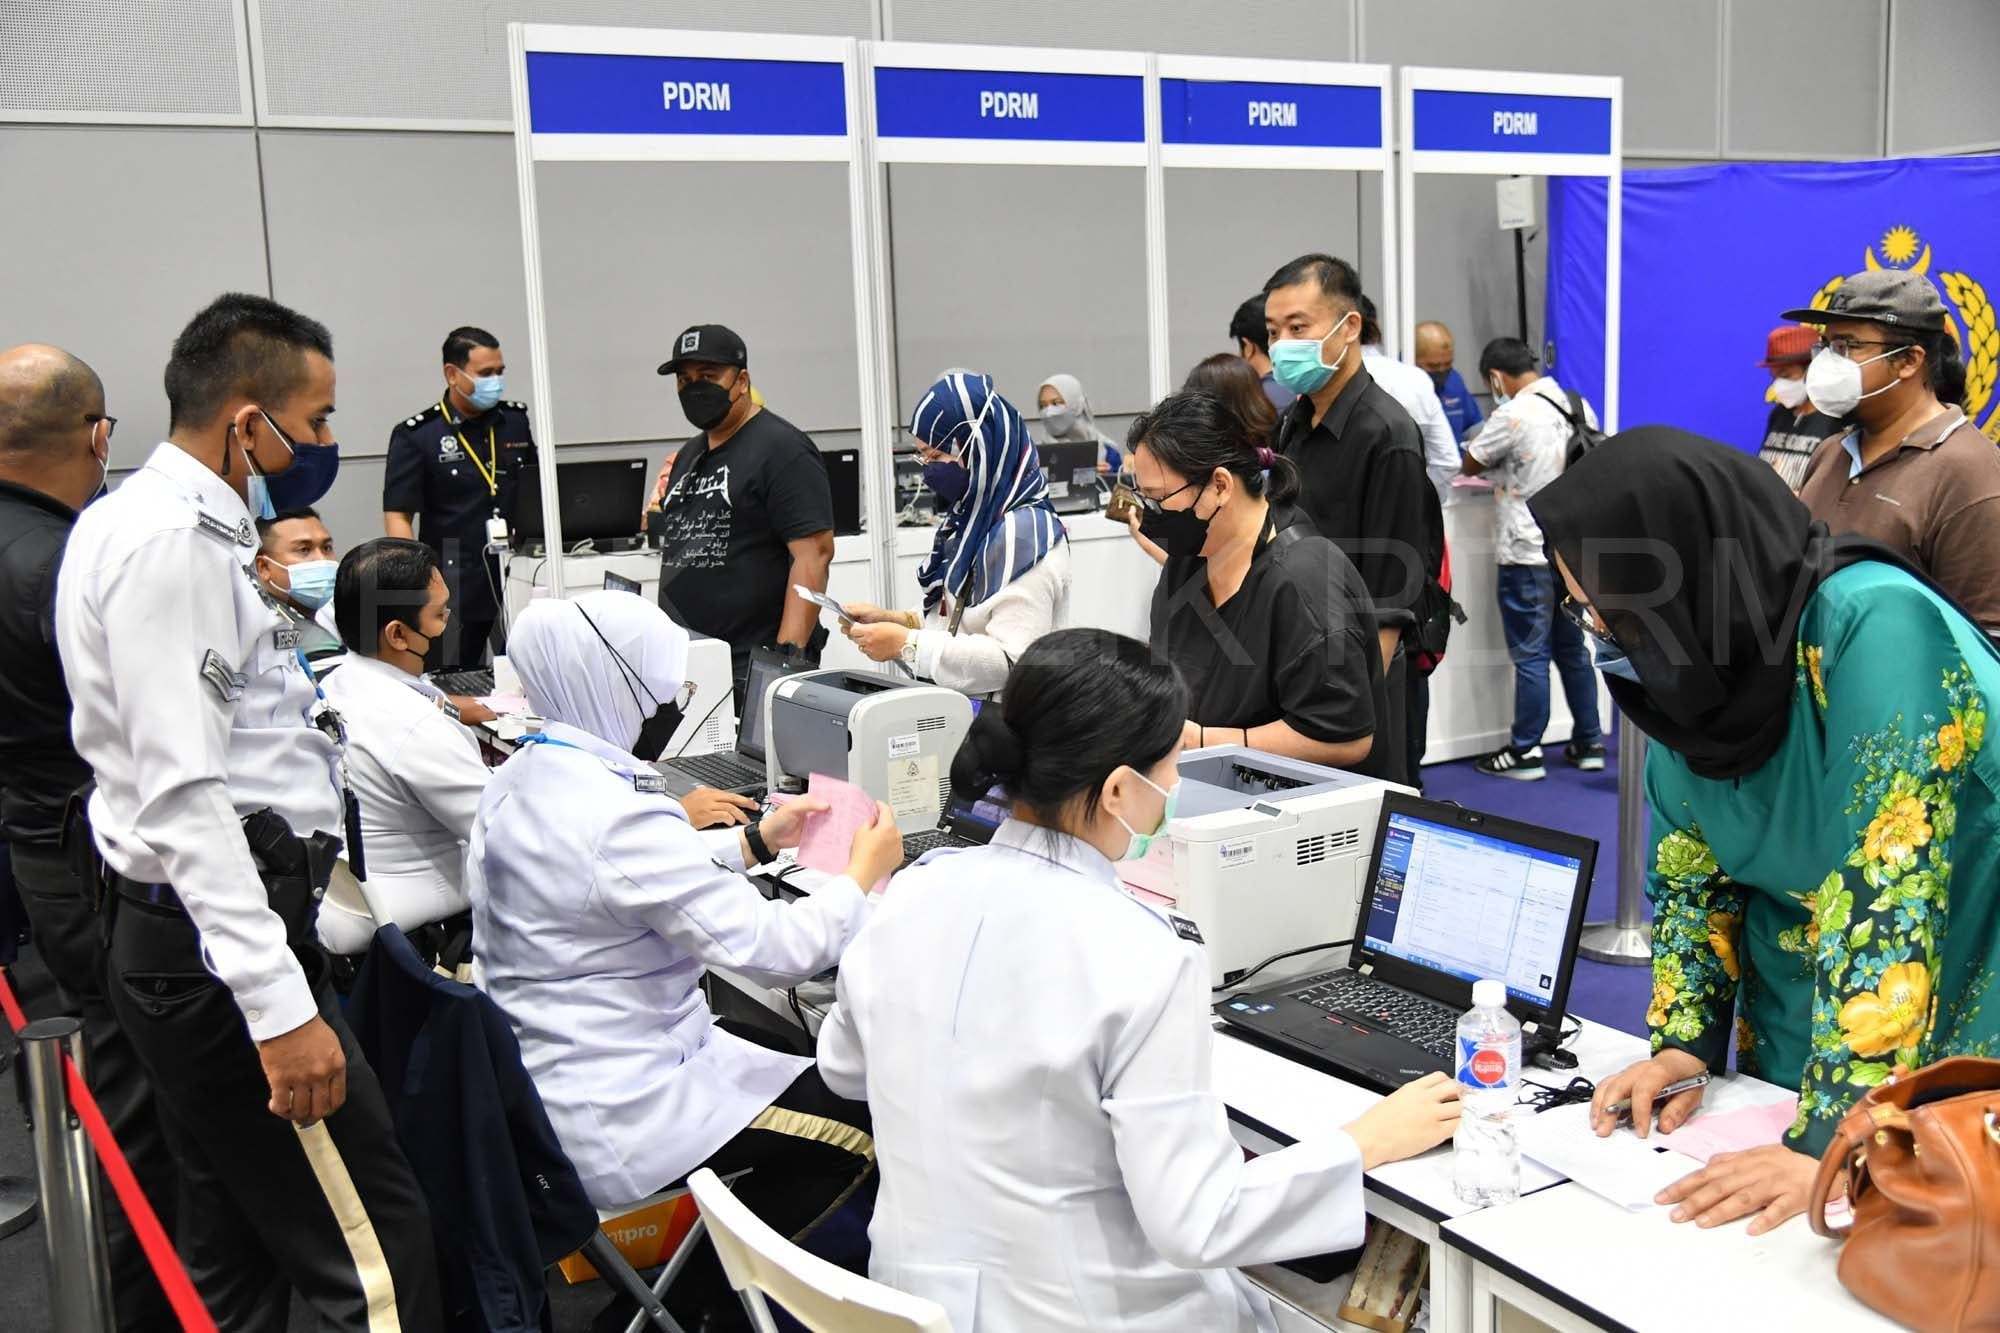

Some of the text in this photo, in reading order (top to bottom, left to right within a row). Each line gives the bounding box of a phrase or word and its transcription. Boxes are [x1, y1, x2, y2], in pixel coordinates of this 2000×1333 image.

[663, 81, 731, 111] PDRM
[980, 91, 1039, 119] PDRM
[1248, 101, 1297, 127] PDRM
[1493, 111, 1537, 135] PDRM
[606, 1224, 658, 1246] ntpro
